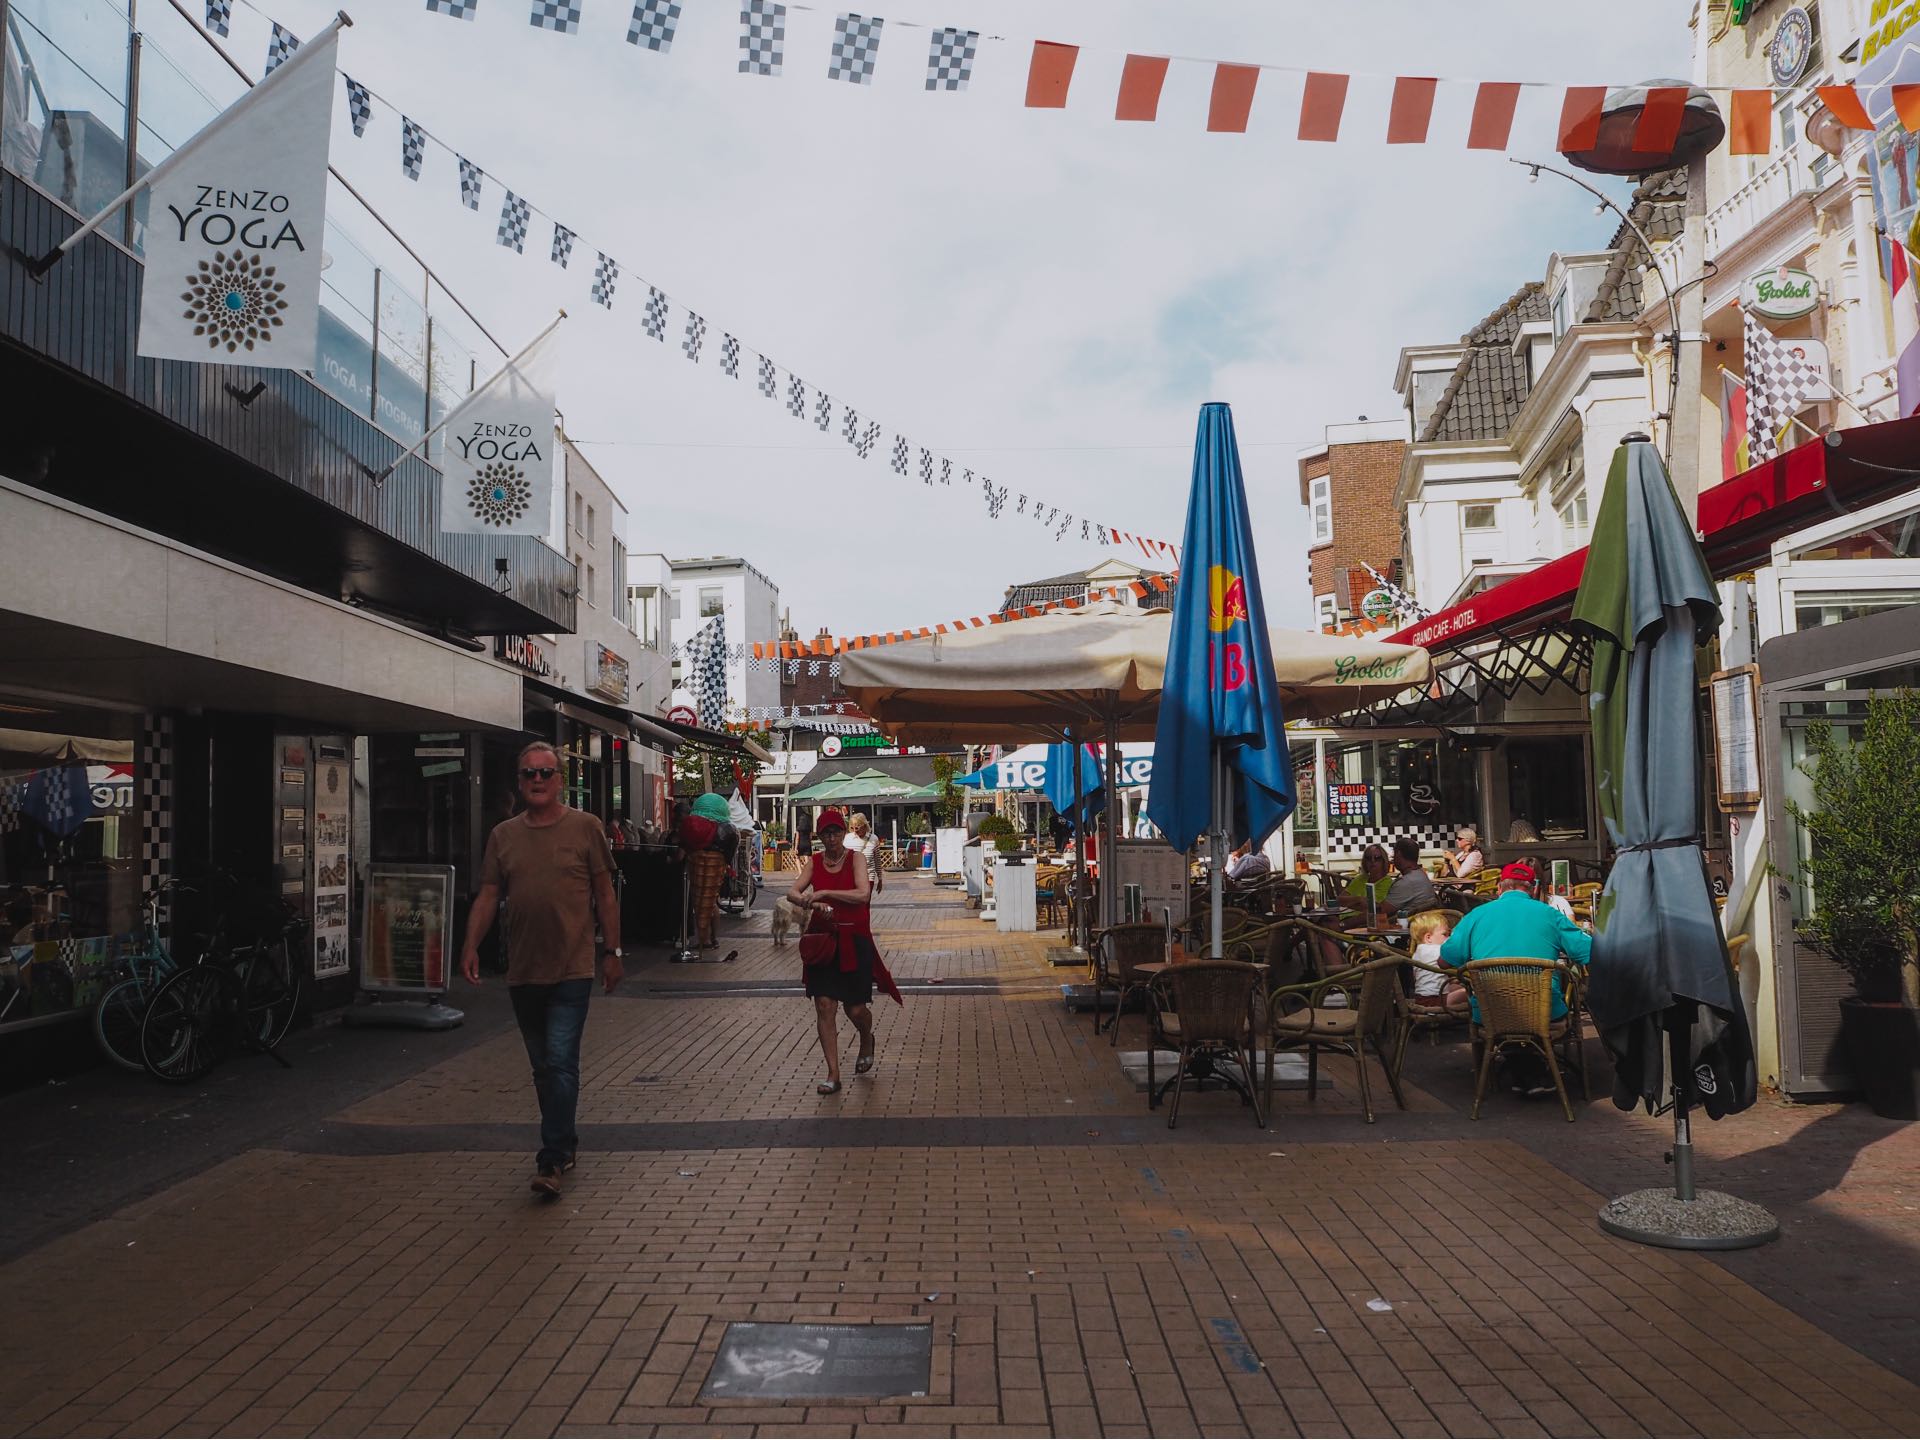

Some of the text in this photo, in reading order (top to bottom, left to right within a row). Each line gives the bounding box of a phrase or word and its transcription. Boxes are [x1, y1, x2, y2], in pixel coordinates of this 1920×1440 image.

[196, 185, 290, 212] ZENZO
[168, 204, 305, 252] YOGA
[1756, 279, 1811, 304] Grolsch
[322, 353, 358, 393] YOGA
[366, 385, 421, 437] FTOGRAFI
[473, 422, 532, 437] ZENZO
[457, 435, 542, 462] YOGA
[1412, 626, 1432, 647] GRAND
[1433, 619, 1449, 639] CAFE
[1453, 609, 1477, 631] HOTEL
[1334, 655, 1407, 685] Grolsch
[1329, 785, 1340, 816] START
[1338, 784, 1367, 796] YOUR
[1340, 795, 1368, 803] ENGINES
